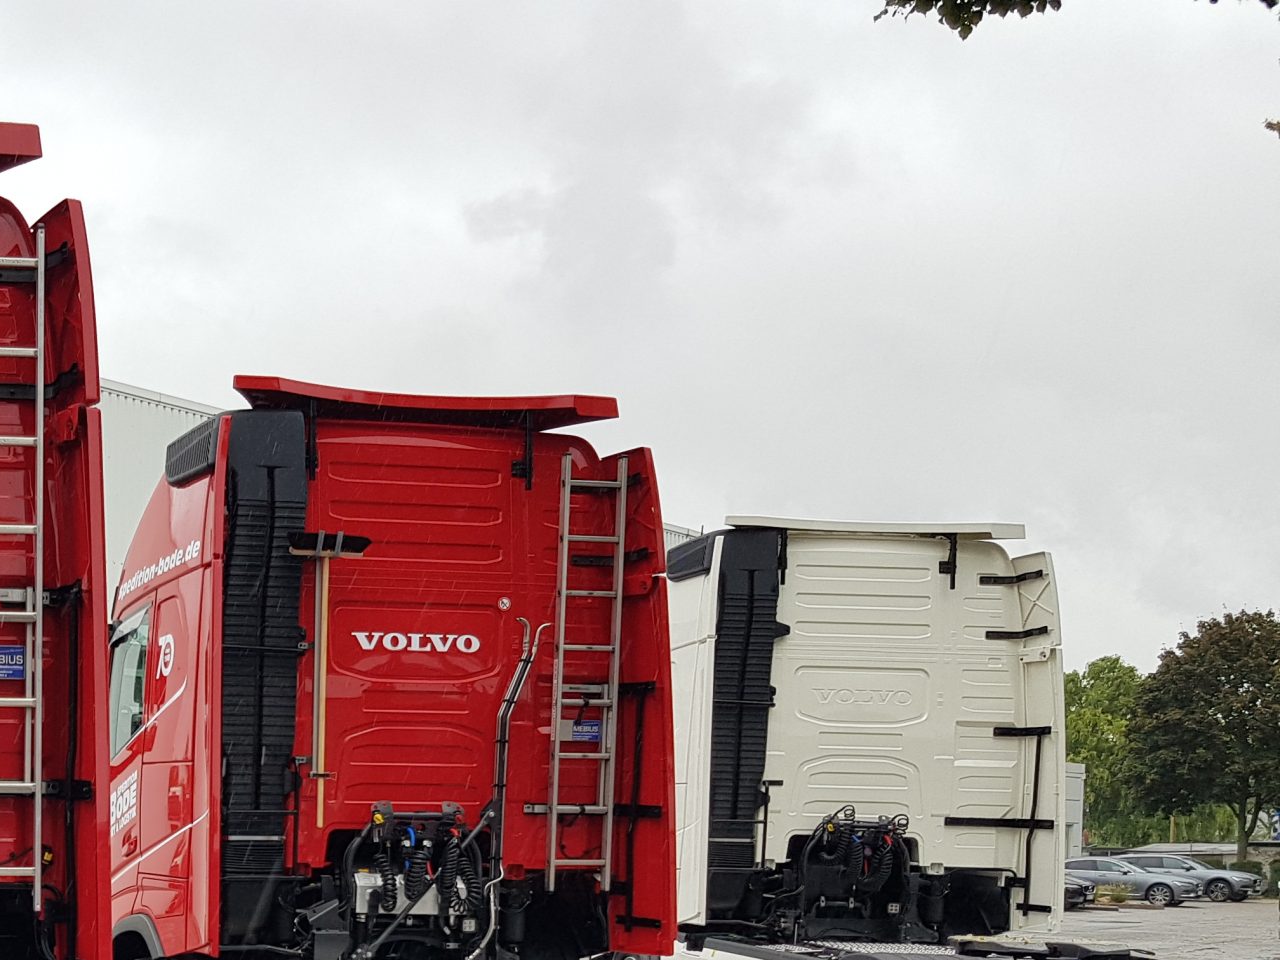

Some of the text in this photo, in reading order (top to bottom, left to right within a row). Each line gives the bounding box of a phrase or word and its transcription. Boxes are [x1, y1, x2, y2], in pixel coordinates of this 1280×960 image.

[117, 540, 201, 601] spedition-bode.de
[351, 631, 481, 654] VOLVO
[810, 687, 913, 706] VOLVO
